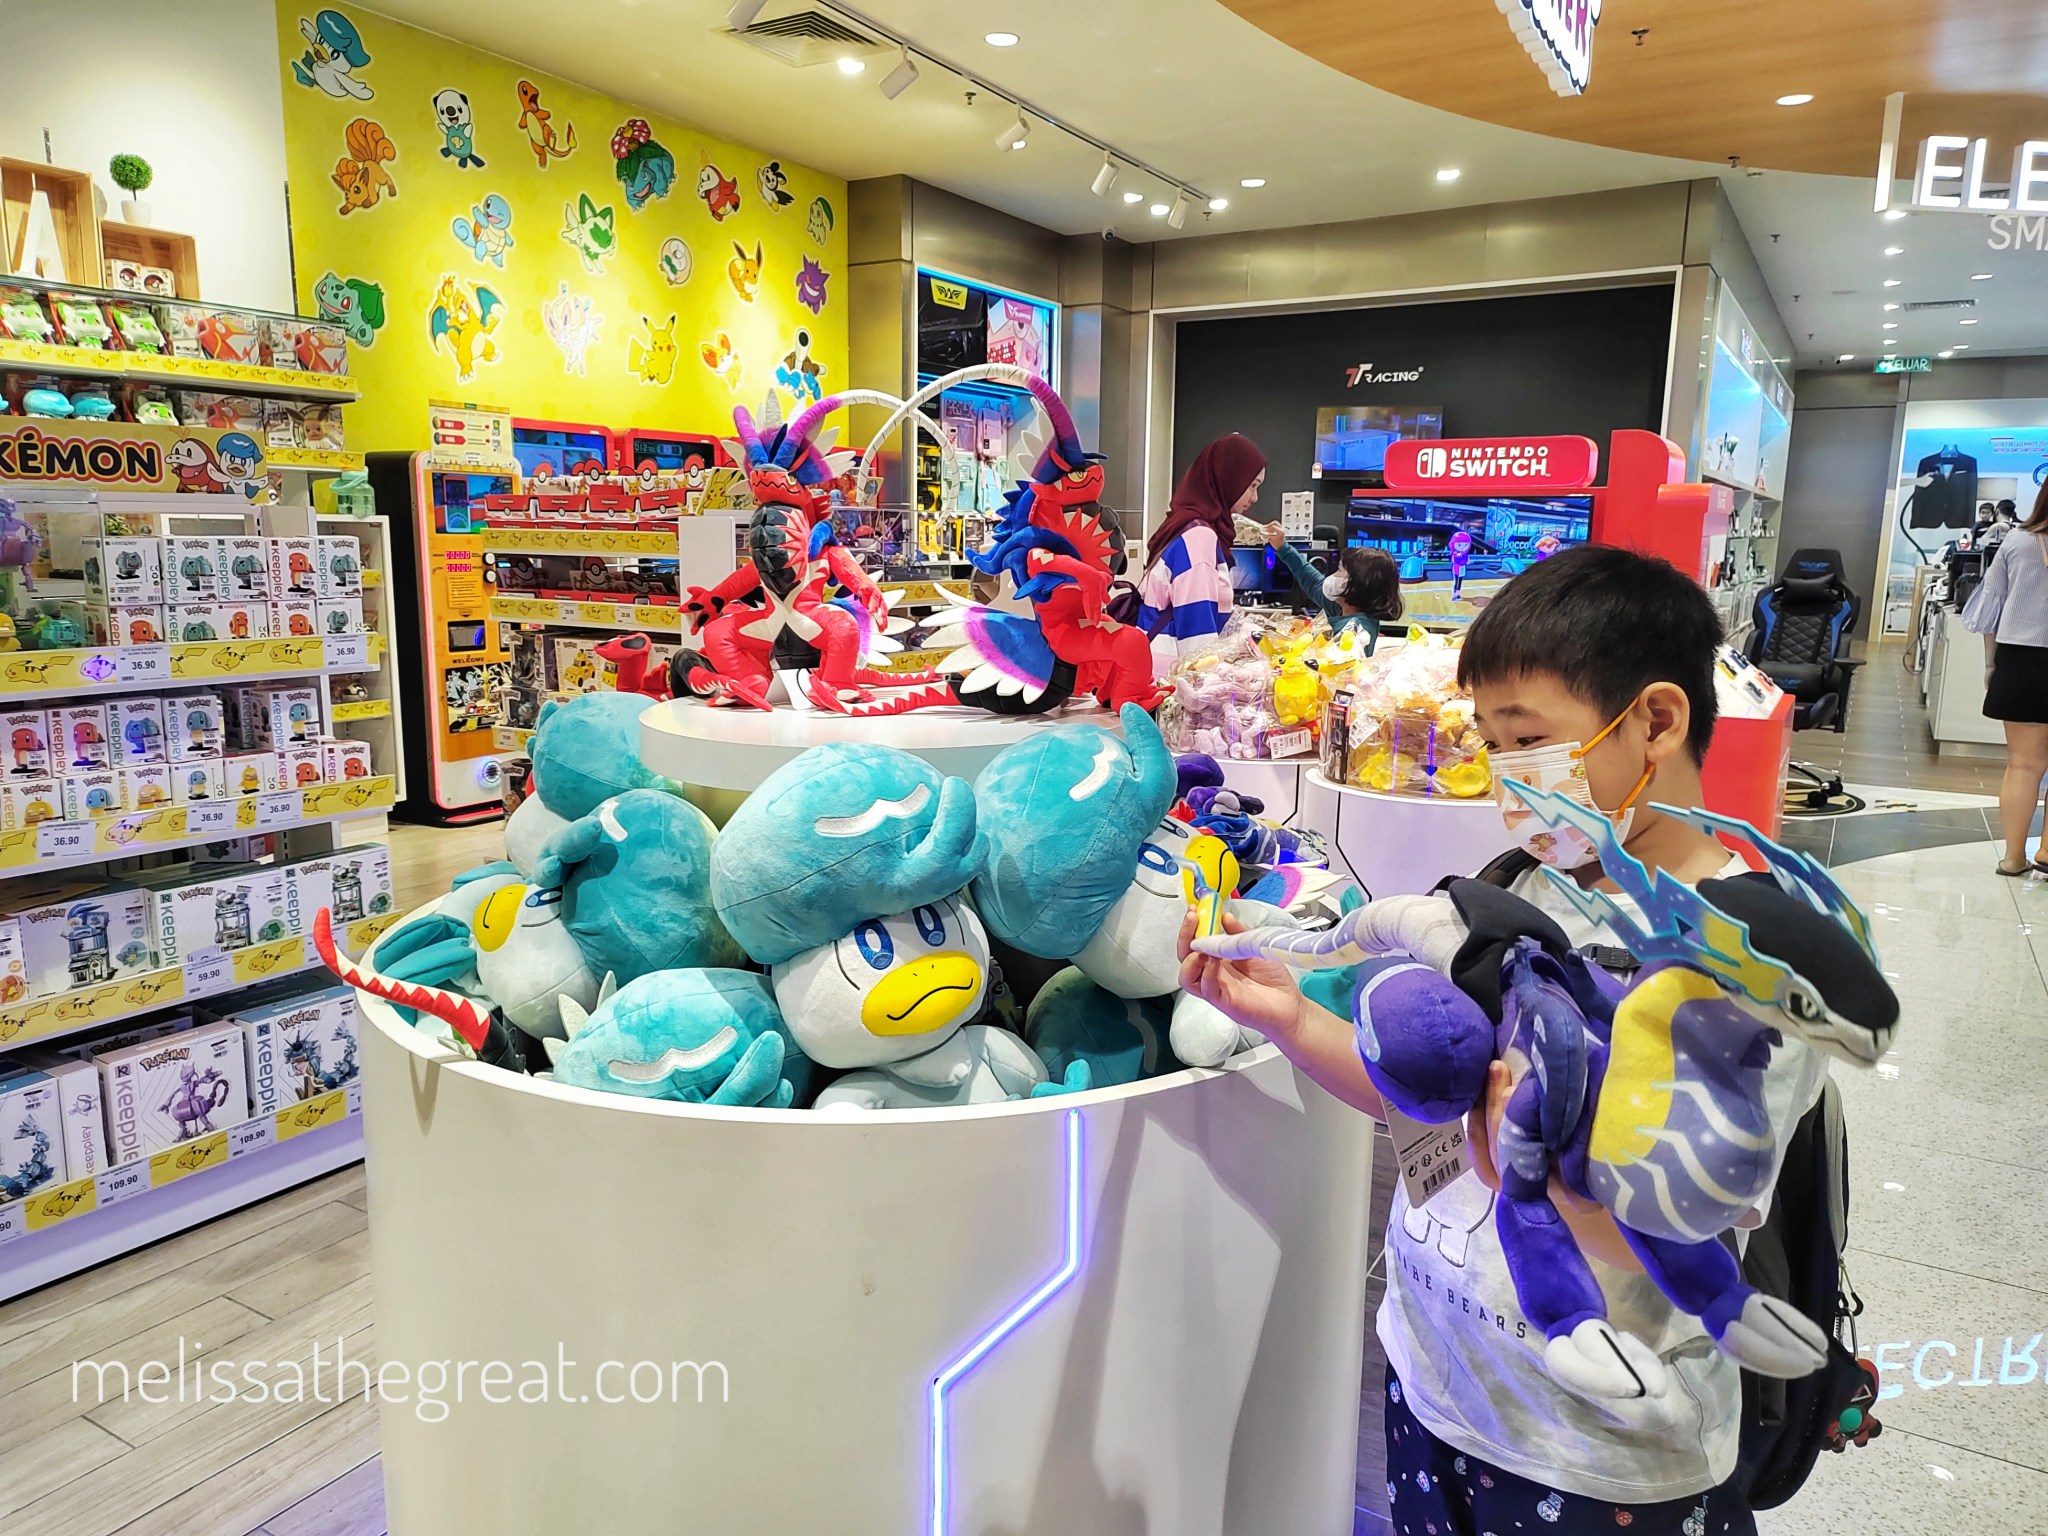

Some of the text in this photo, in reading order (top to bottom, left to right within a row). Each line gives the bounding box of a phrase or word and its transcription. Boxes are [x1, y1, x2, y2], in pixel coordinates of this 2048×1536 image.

[1987, 215, 2048, 251] SM
[1889, 358, 1928, 371] KELUAR
[1451, 446, 1549, 459] NINTENDO
[1449, 458, 1548, 478] SWITCH
[336, 646, 356, 656] 36.90
[131, 661, 156, 670] 36.90
[452, 656, 485, 665] WELCOME
[269, 803, 291, 814] 36.90
[200, 812, 223, 822] 36.90
[53, 836, 80, 846] 36.90
[286, 880, 304, 935] keeppl
[198, 968, 221, 982] 59.90
[239, 1129, 266, 1145] 109.90
[108, 1174, 138, 1192] 109.90
[1447, 1288, 1527, 1339] BEARS
